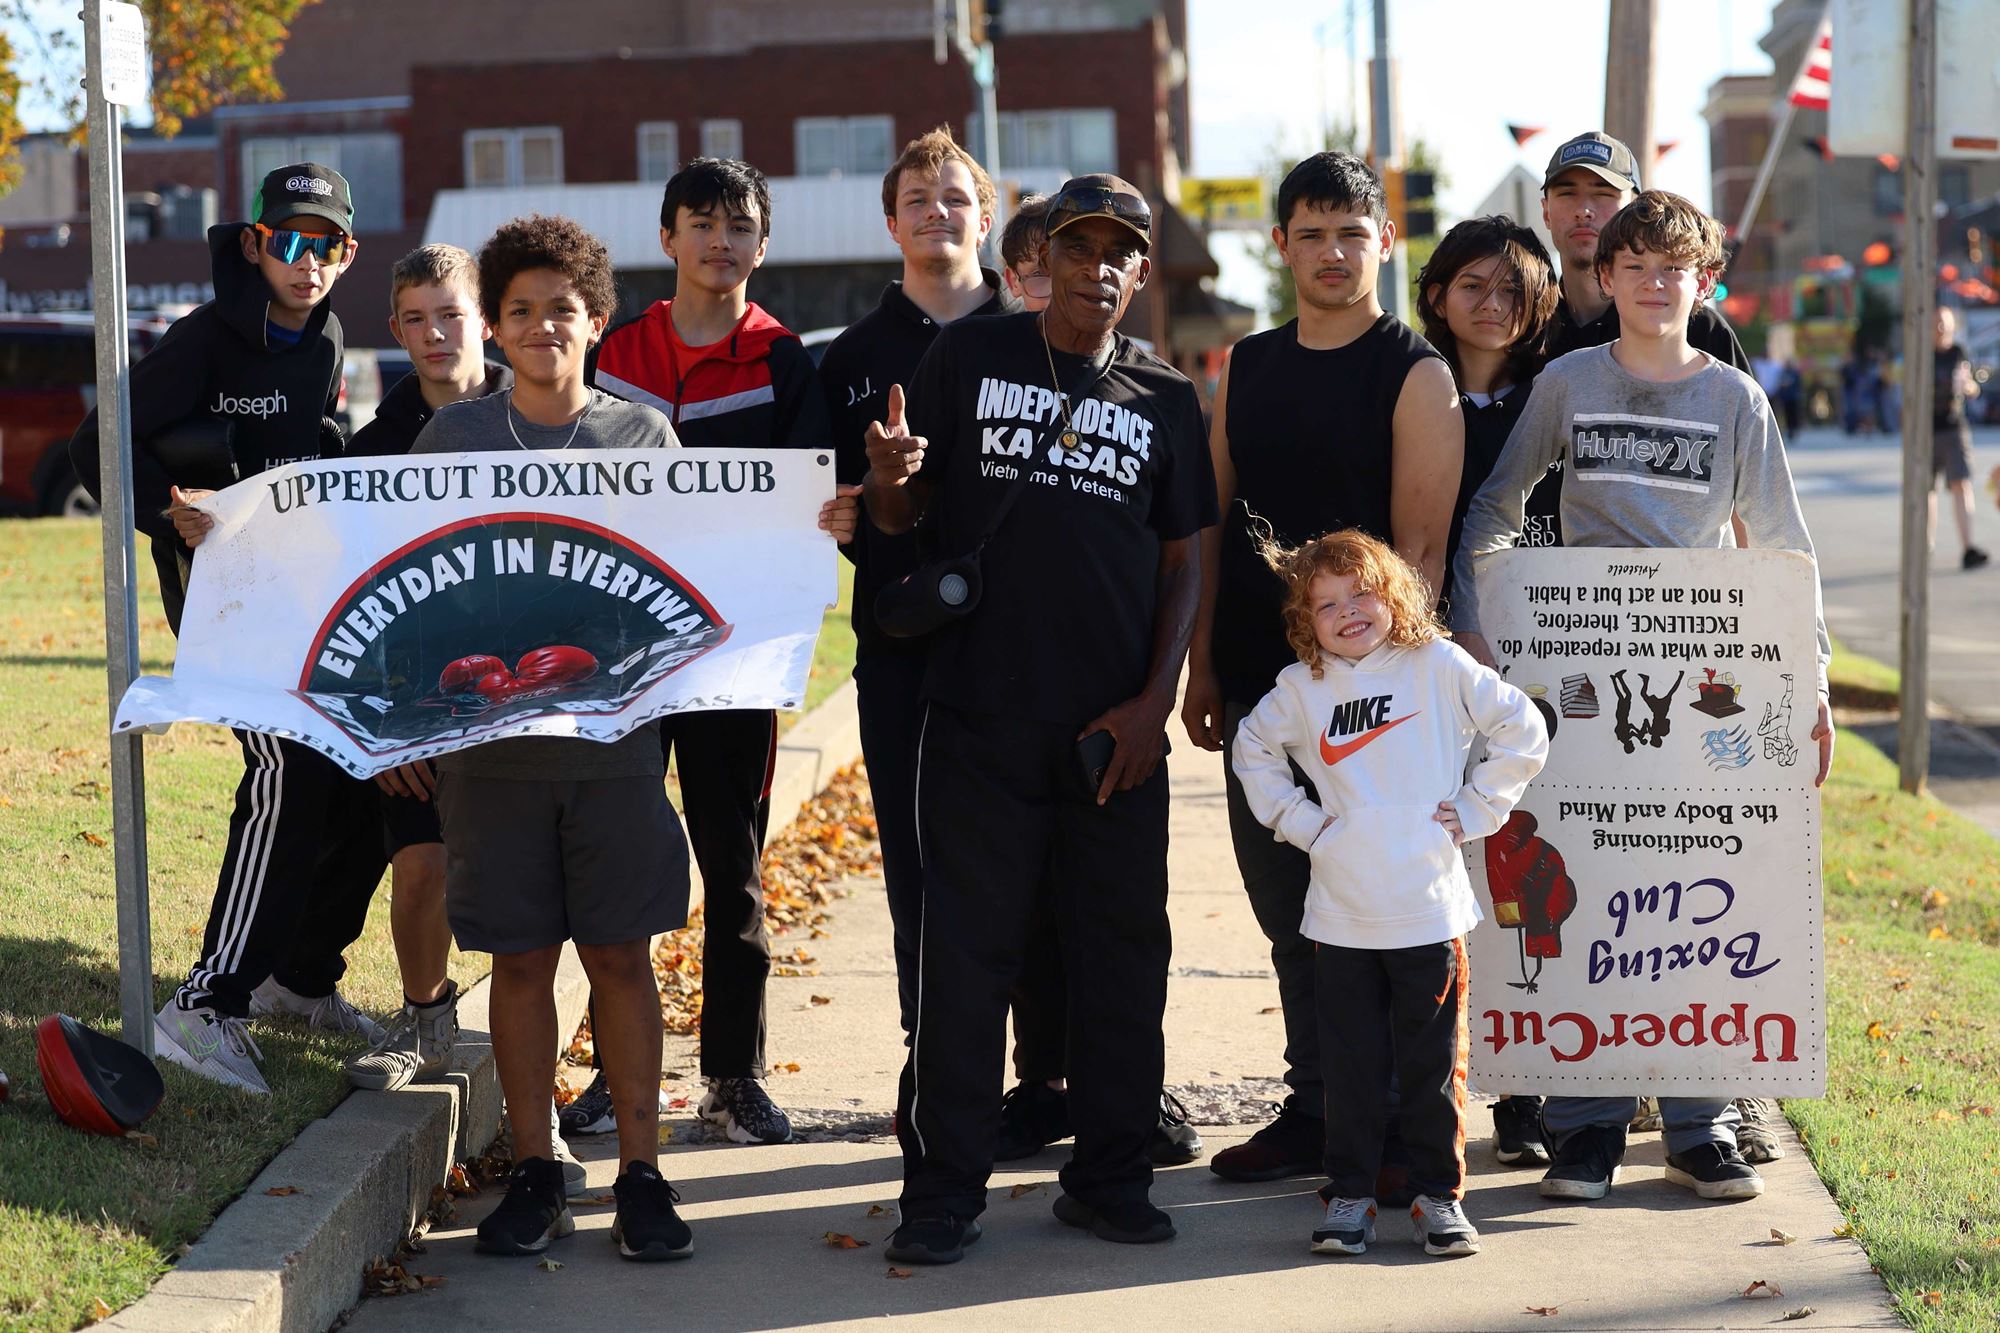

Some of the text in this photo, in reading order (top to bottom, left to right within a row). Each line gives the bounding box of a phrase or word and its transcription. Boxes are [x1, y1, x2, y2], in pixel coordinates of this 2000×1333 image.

[210, 389, 288, 420] Joseph
[1577, 431, 1675, 467] Hurley
[268, 460, 776, 514] UPPERCUT BOXING CLUB
[1607, 562, 1661, 580] Aristotle
[319, 543, 477, 679] EVERYDAY
[492, 537, 534, 576] IN
[1523, 585, 1744, 607] is not an act but a habit.
[1532, 611, 1739, 634] EXCELLENCE, therefore,
[1497, 636, 1782, 662] We are what we repeatedly do.
[1327, 694, 1393, 738] NIKE
[1559, 800, 1779, 824] the Body and Mind
[1592, 829, 1743, 855] Conditioning
[1607, 877, 1735, 938] Club
[1588, 931, 1781, 984] Boxing
[1483, 1003, 1799, 1063] UpperCut
